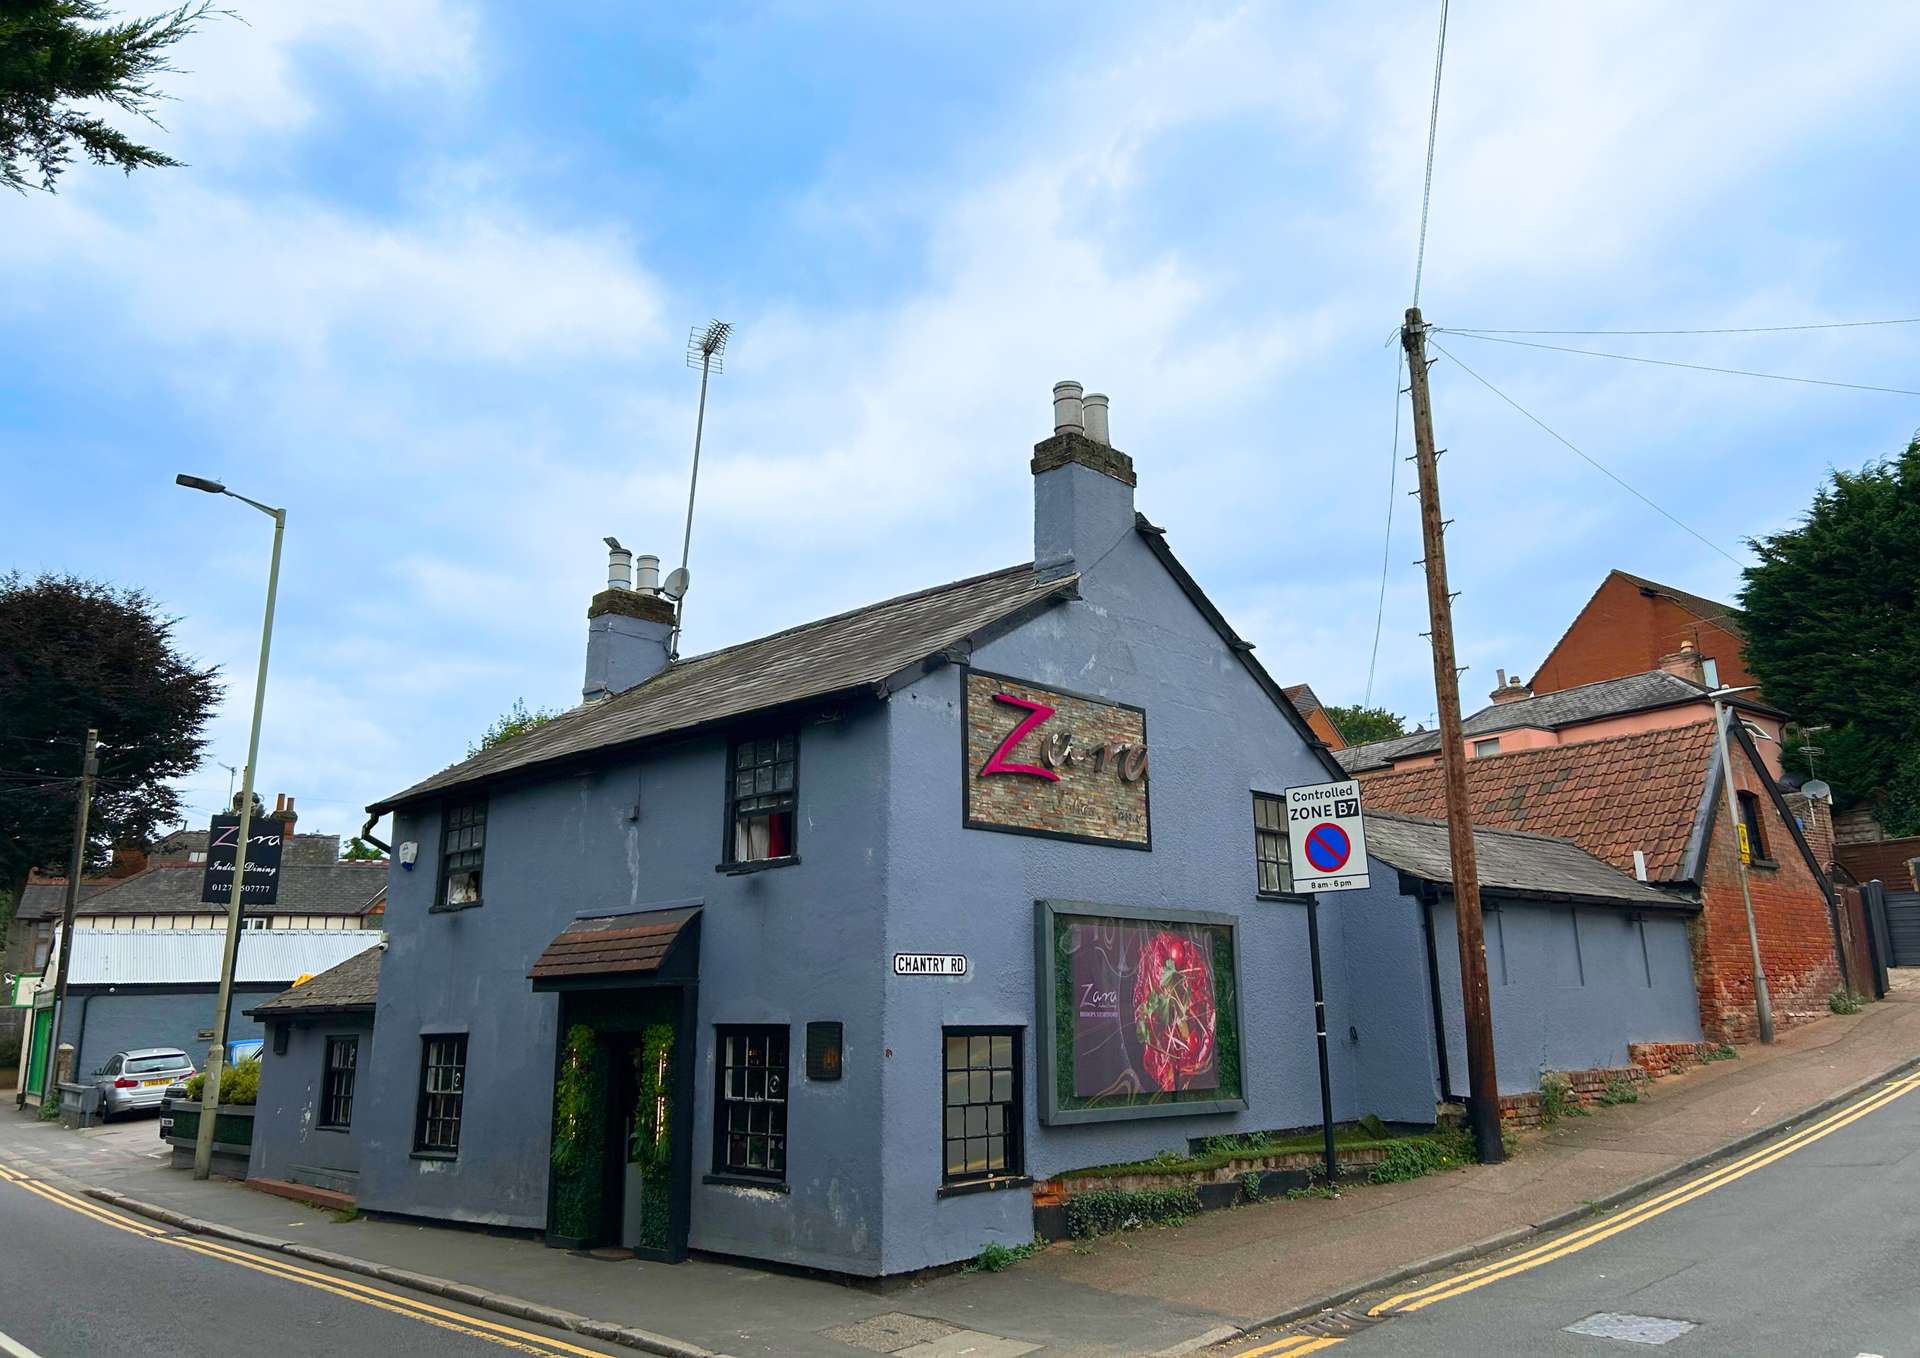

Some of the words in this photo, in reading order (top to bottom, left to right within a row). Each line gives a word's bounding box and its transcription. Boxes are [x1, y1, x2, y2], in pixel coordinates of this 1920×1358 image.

[977, 692, 1149, 783] Zara
[1292, 785, 1353, 802] Controlled
[1290, 804, 1332, 821] ZONE
[1338, 801, 1357, 815] B7
[211, 825, 280, 848] Zra
[209, 860, 238, 872] India
[243, 861, 276, 877] Dining
[211, 883, 236, 892] 0127
[1340, 880, 1352, 888] pm
[898, 957, 945, 972] CHANTRY
[951, 958, 963, 972] RD
[1080, 983, 1117, 1007] Zara
